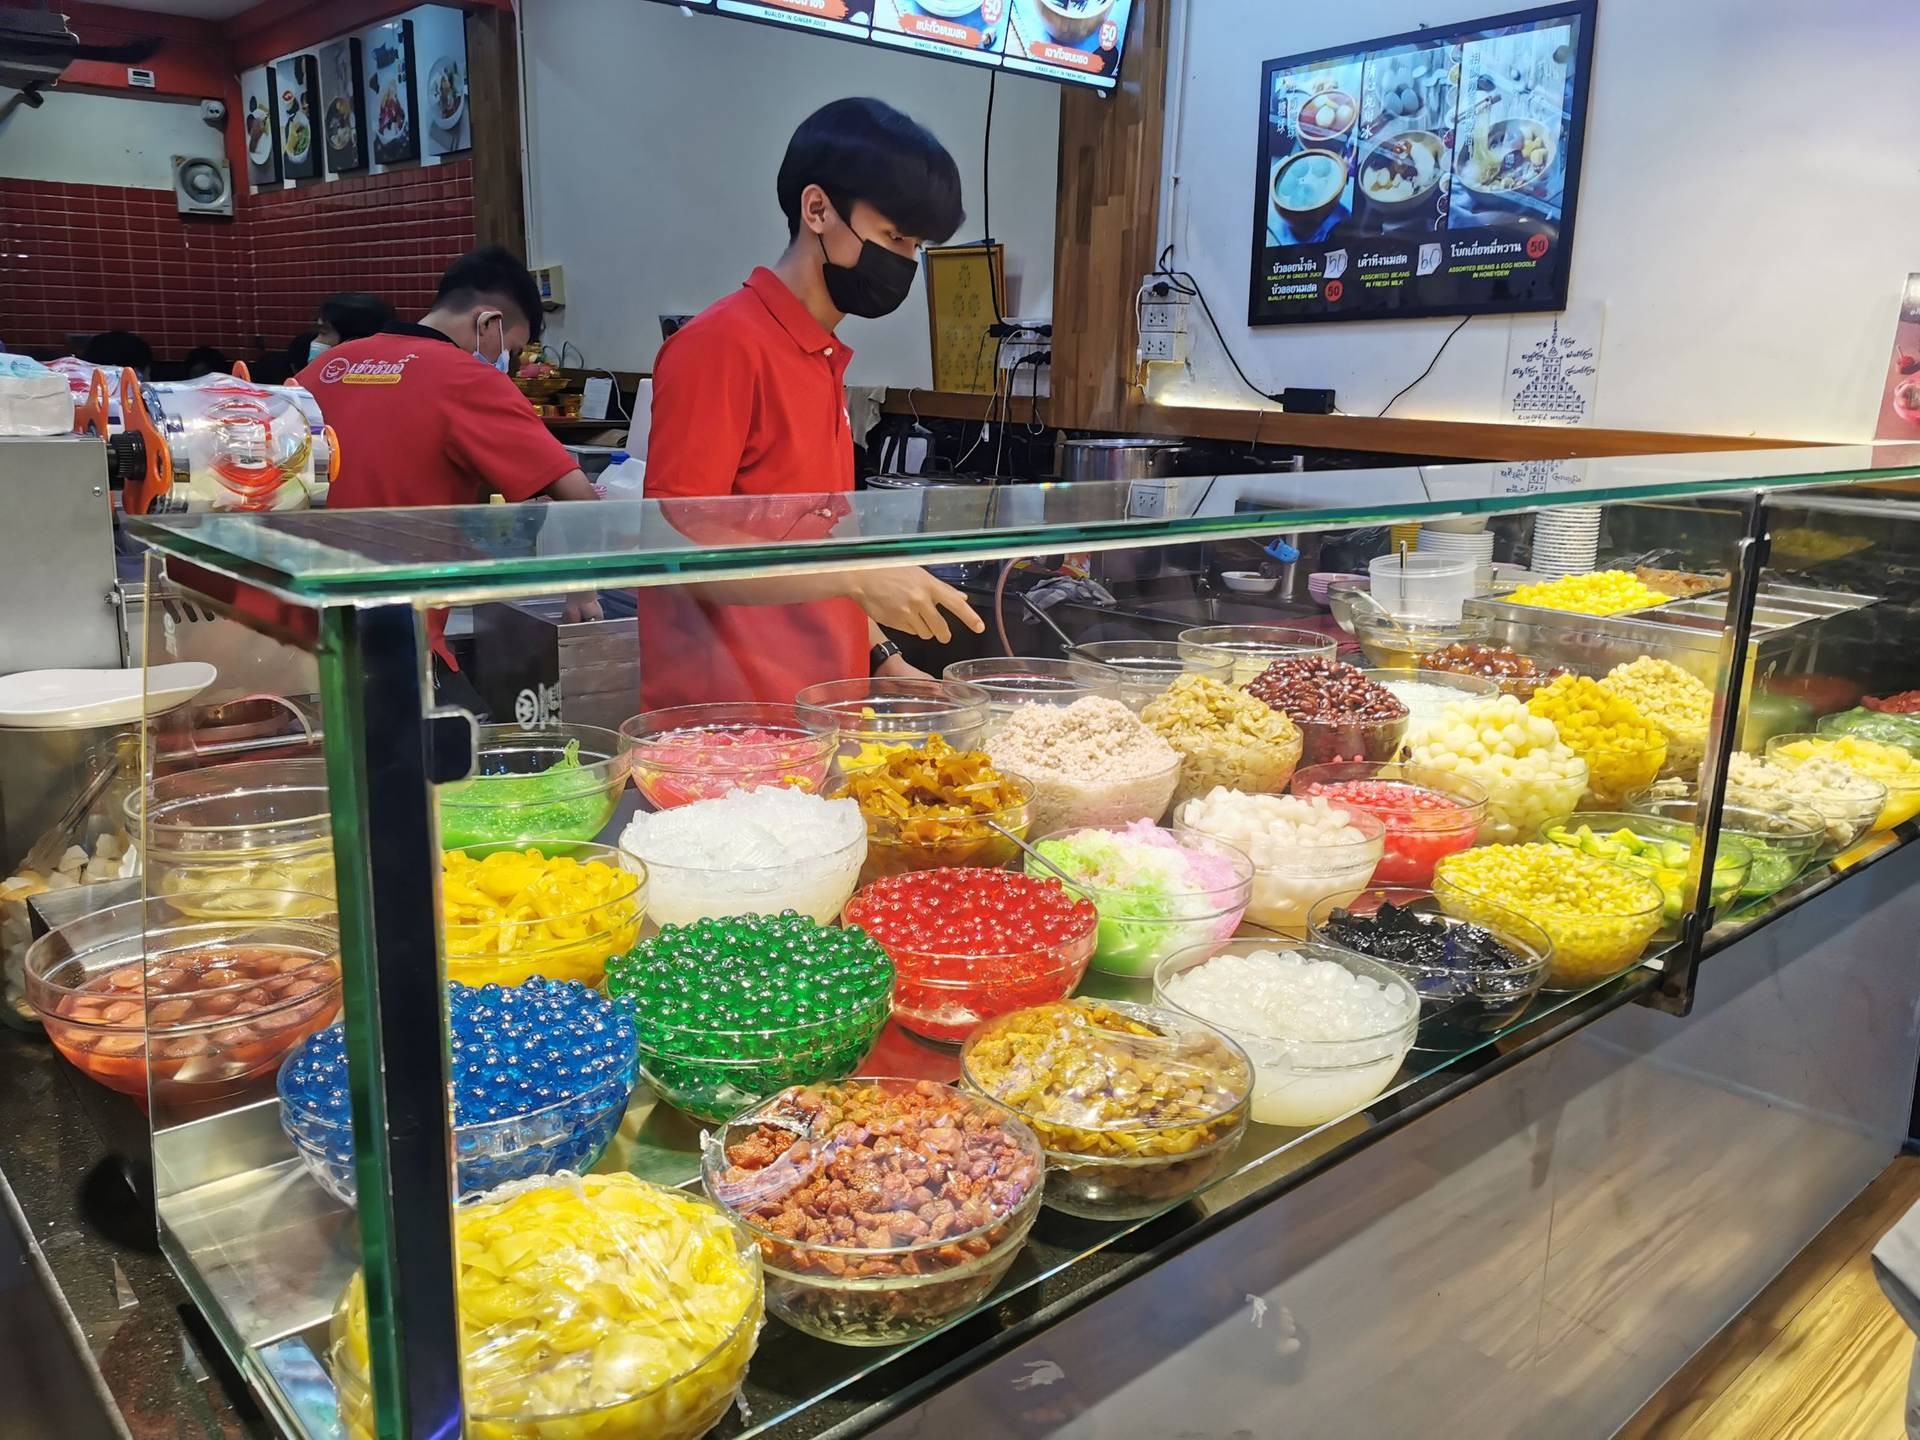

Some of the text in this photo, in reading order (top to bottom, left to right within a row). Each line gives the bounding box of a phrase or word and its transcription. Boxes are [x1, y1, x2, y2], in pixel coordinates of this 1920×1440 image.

[1102, 25, 1117, 42] 50
[1530, 239, 1545, 253] 50
[1273, 257, 1317, 274] บัวลอยน้ำขิง
[1328, 254, 1347, 274] 50
[1421, 248, 1441, 270] 60
[1448, 264, 1477, 273] ASSORTED
[1477, 263, 1495, 271] BEANS
[1513, 260, 1537, 268] NOODLE
[1360, 272, 1389, 281] ASSORTED
[1479, 270, 1511, 278] HONEYDEW
[1271, 283, 1317, 295] บัวลอยนมสด
[1372, 280, 1390, 288] FRESH
[1327, 286, 1340, 297] 50
